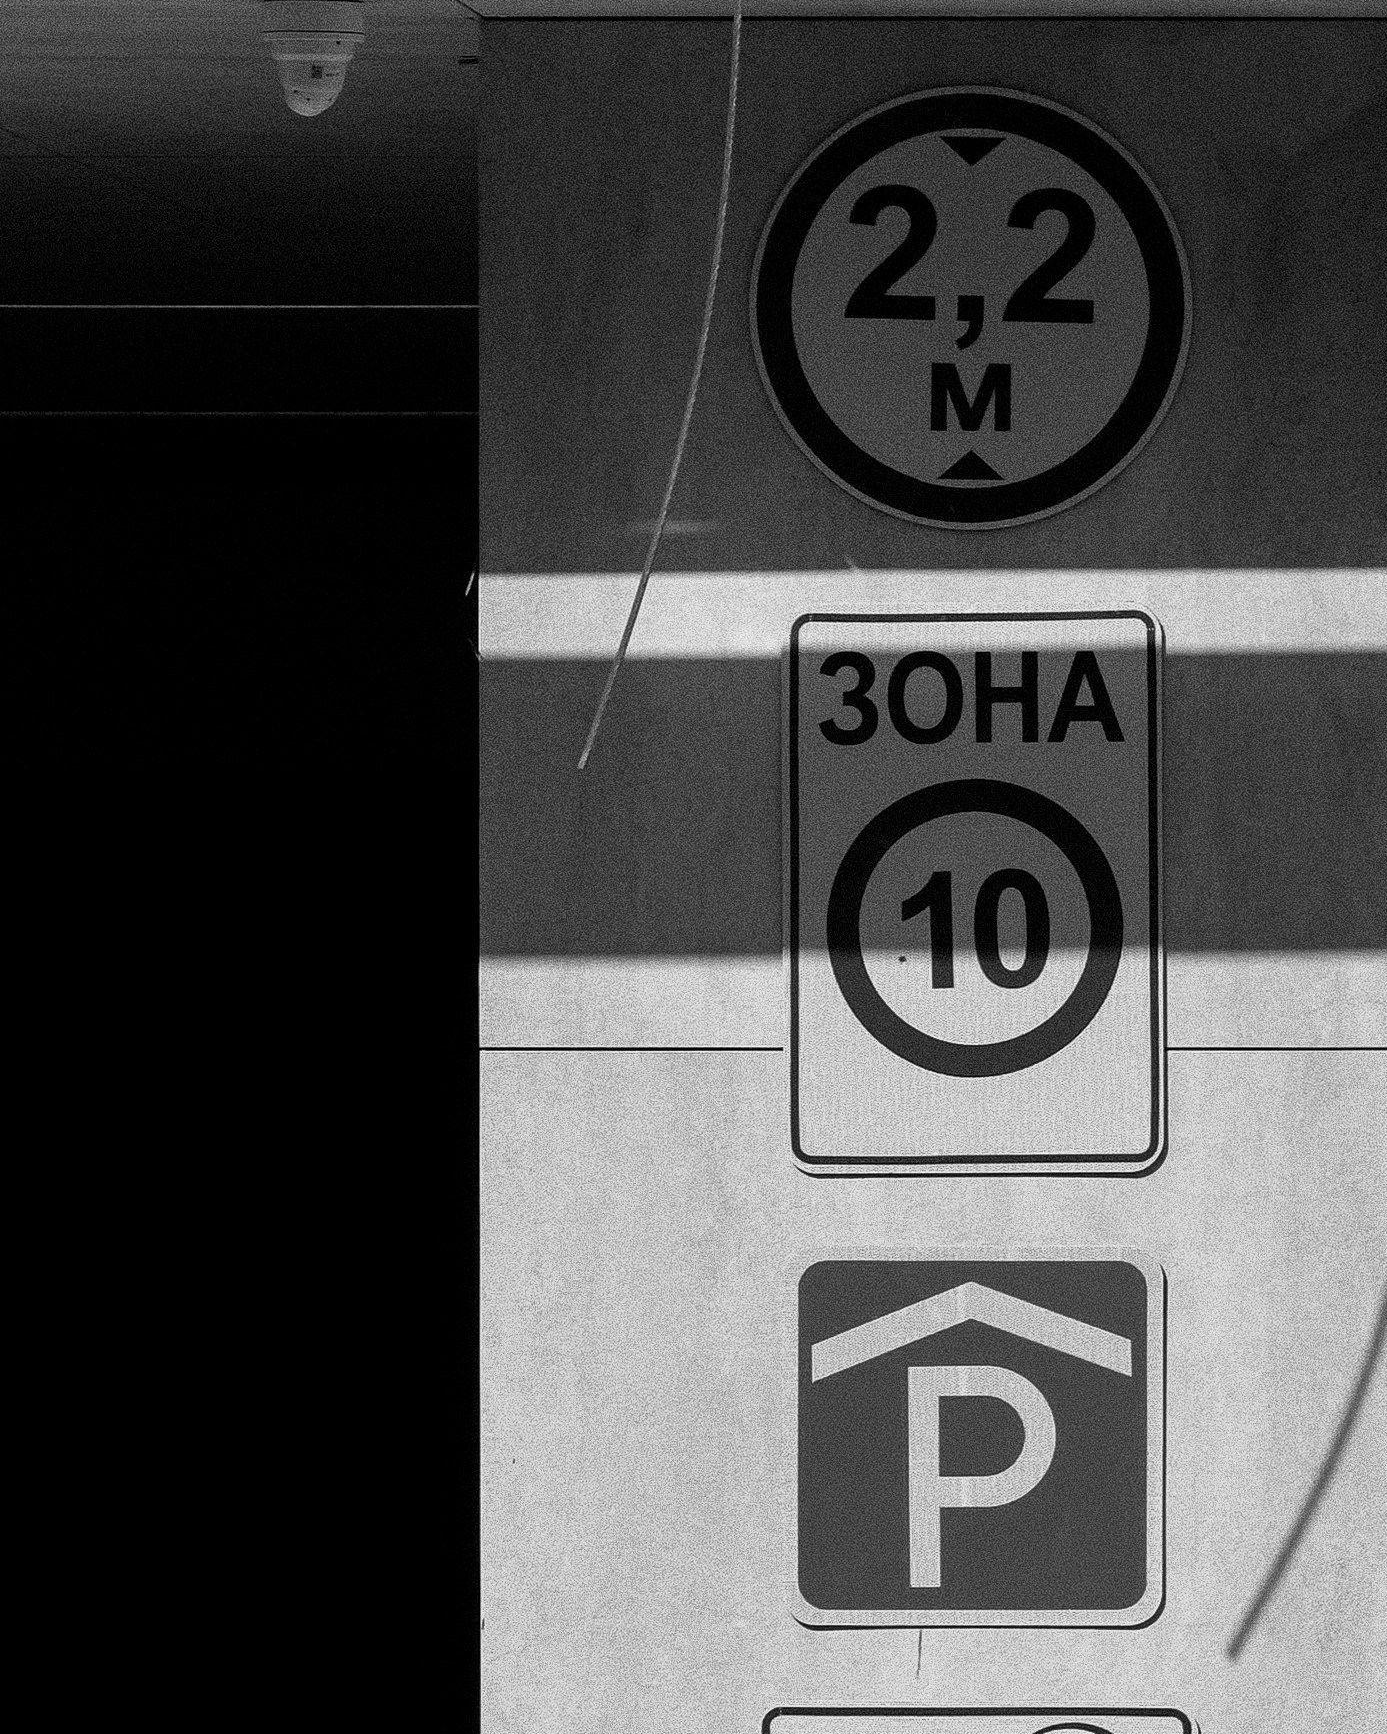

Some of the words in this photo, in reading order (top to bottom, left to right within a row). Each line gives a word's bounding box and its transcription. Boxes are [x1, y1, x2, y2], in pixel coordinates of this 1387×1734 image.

[844, 184, 1095, 351] 2,2
[819, 650, 1125, 745] ЗОНА
[899, 869, 1051, 989] 10
[907, 1365, 1057, 1588] P
